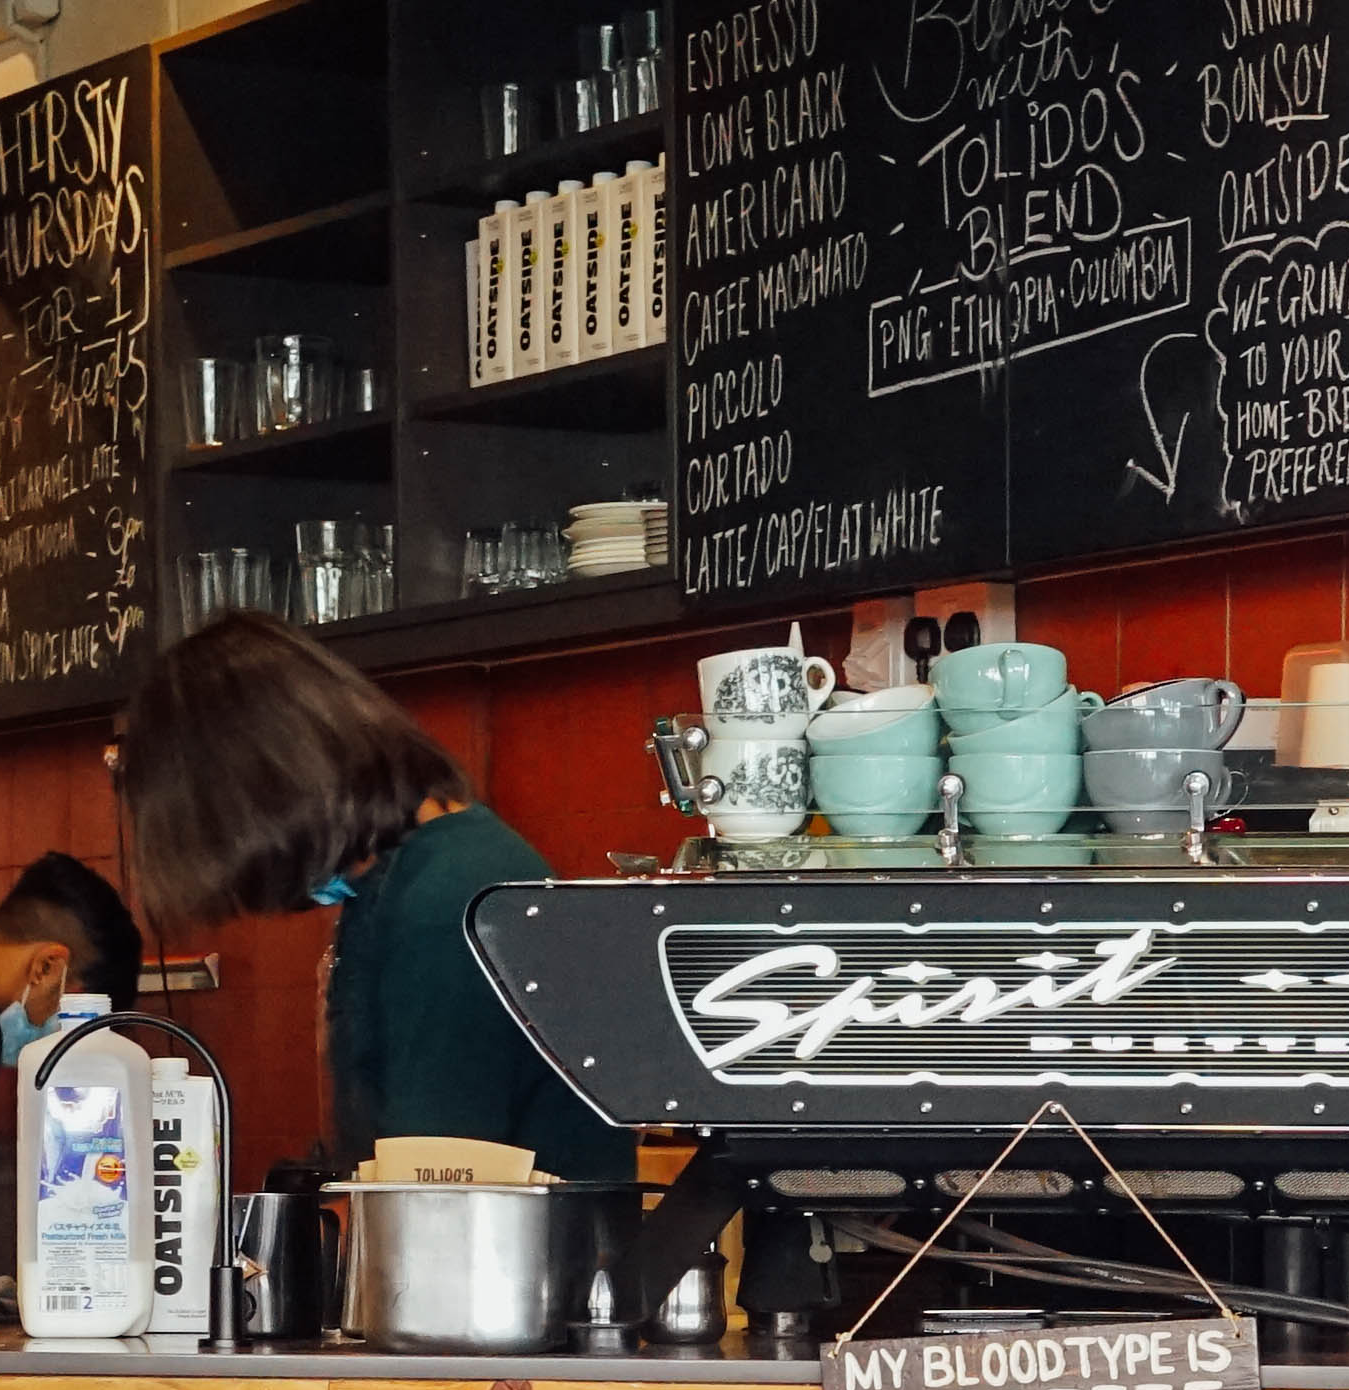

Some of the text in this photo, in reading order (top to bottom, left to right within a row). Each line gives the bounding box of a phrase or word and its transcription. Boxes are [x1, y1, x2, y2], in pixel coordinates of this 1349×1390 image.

[687, 0, 818, 93] ESPRESSO
[687, 64, 846, 178] LONG BLACK
[619, 201, 632, 327] OATSIDE
[652, 191, 666, 318] OATSIDE
[686, 151, 846, 268] AMERICANO
[956, 164, 1122, 281] BLEND
[487, 238, 499, 359] OATSIDE
[520, 229, 532, 351] OATSIDE
[551, 221, 564, 344] OATSIDE
[586, 211, 598, 335] OATSIDE
[683, 232, 867, 366] CAFFE MACCHIATO
[880, 306, 932, 369] PNG
[1069, 235, 1179, 309] COLOMBIA
[1233, 276, 1273, 334] WE
[687, 354, 782, 443] PICCOLO
[1240, 341, 1267, 388] TO
[687, 430, 792, 515] CORTADO
[870, 485, 944, 561] WHITE
[693, 926, 1177, 1071] Spirit
[153, 1118, 182, 1296] OATSIDE
[414, 1168, 474, 1182] TOLIDO'S
[1187, 1330, 1232, 1373] IS
